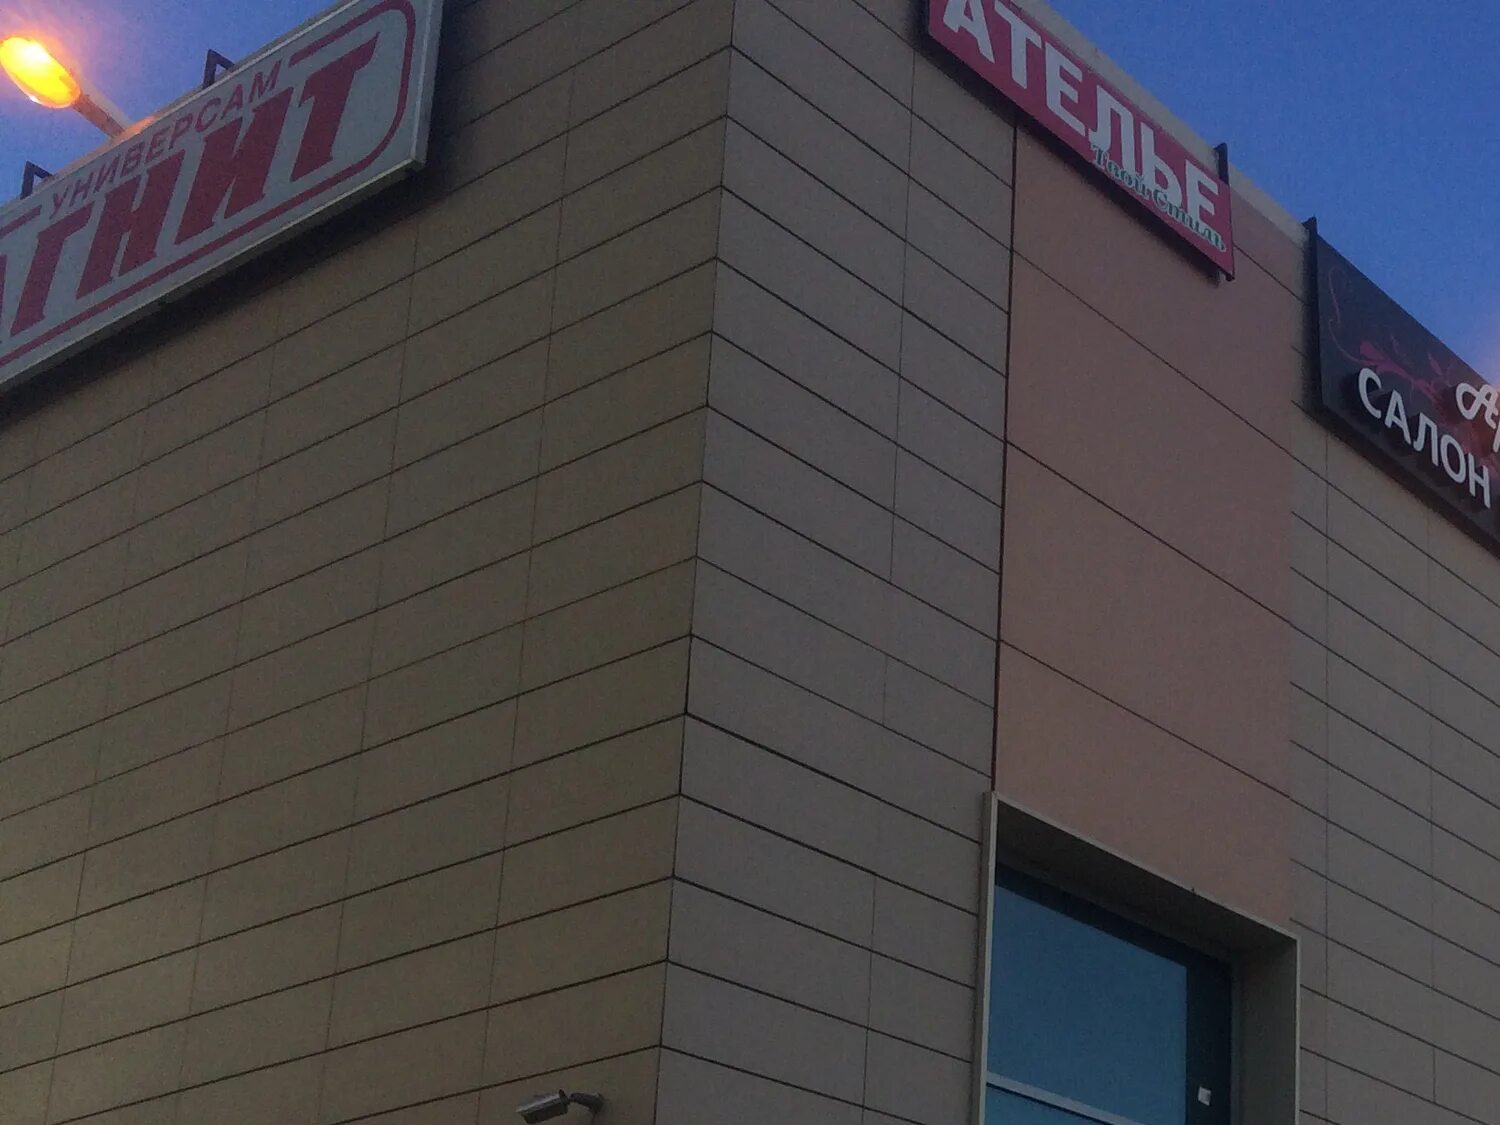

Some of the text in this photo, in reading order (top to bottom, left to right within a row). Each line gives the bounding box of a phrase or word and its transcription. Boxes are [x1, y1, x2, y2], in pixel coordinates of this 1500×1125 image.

[0, 32, 381, 337] ГНИТ
[52, 61, 281, 217] УНИВЕРСАМ
[943, 0, 1219, 242] АТЕЛЬЕ
[1358, 367, 1492, 509] САЛОН
